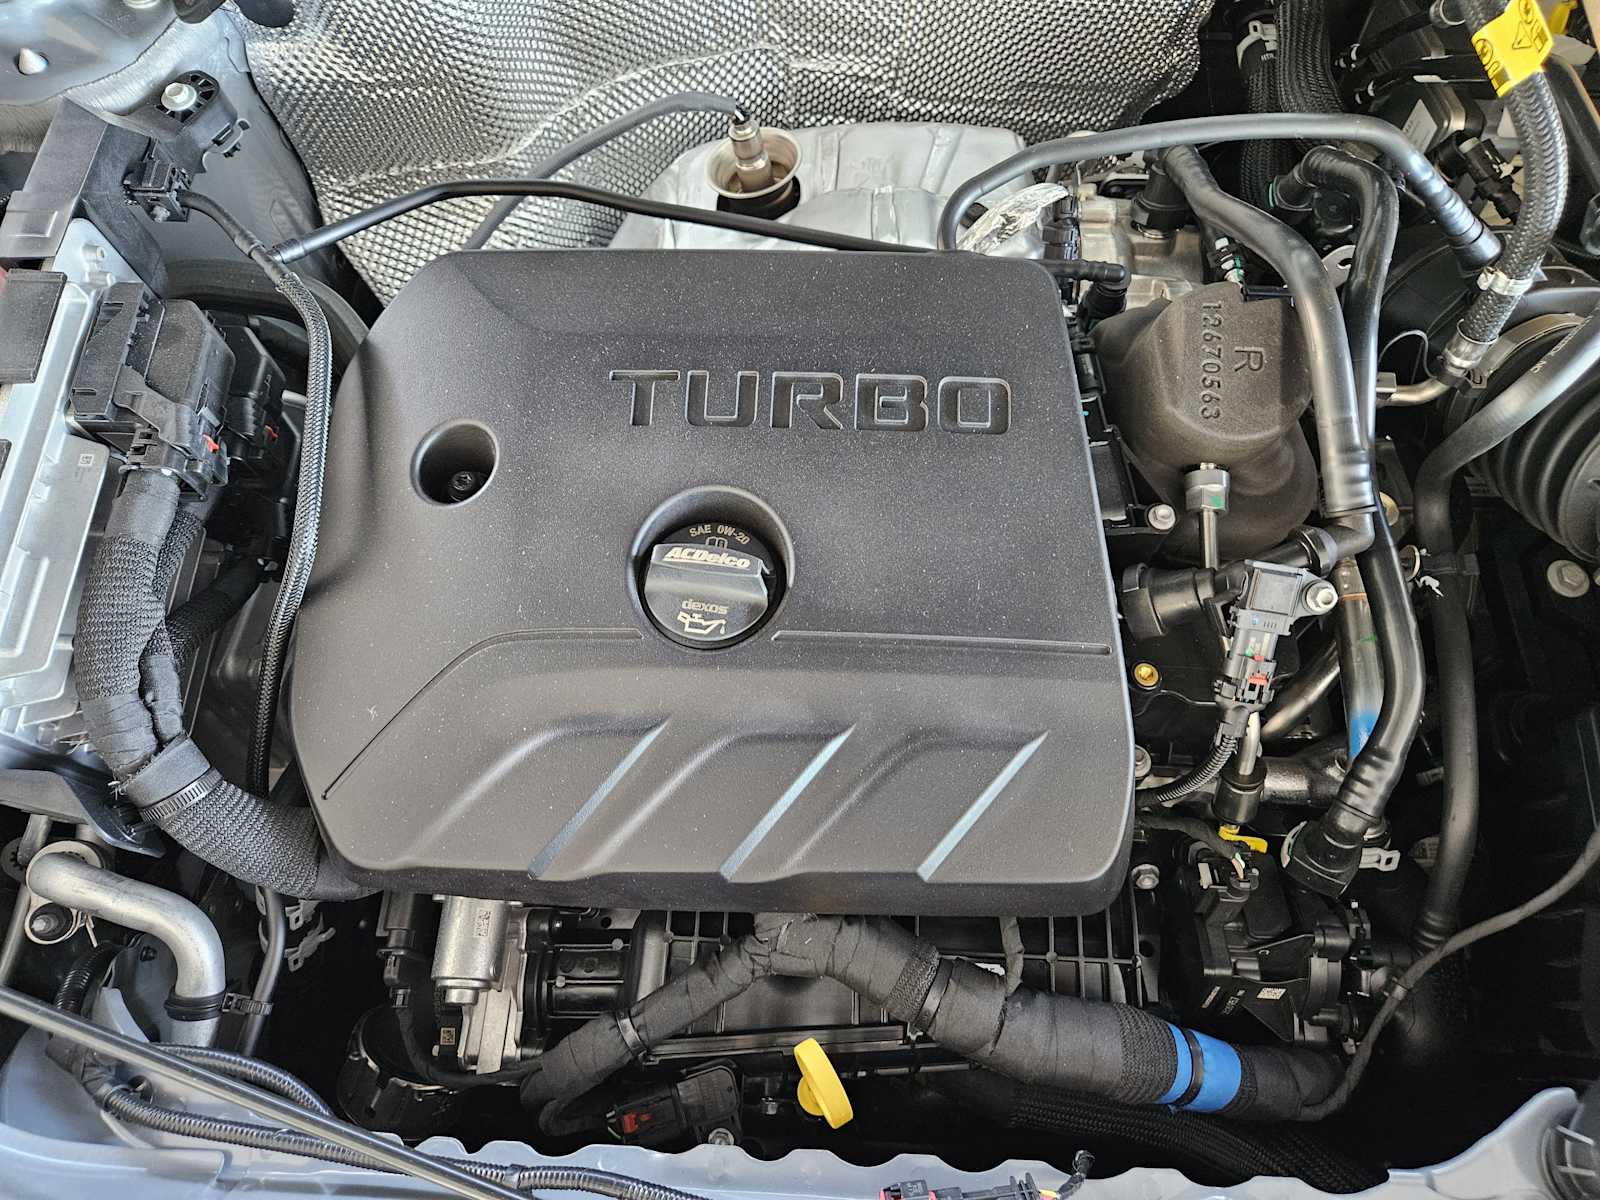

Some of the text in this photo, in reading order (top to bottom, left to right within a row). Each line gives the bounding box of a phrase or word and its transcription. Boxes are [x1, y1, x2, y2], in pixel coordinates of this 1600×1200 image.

[1201, 302, 1223, 420] 12670563
[1234, 346, 1264, 373] R
[608, 370, 1011, 434] TURBO
[689, 524, 750, 544] SAE 0W-20
[664, 546, 751, 568] ACDelco
[681, 599, 728, 614] dexos
